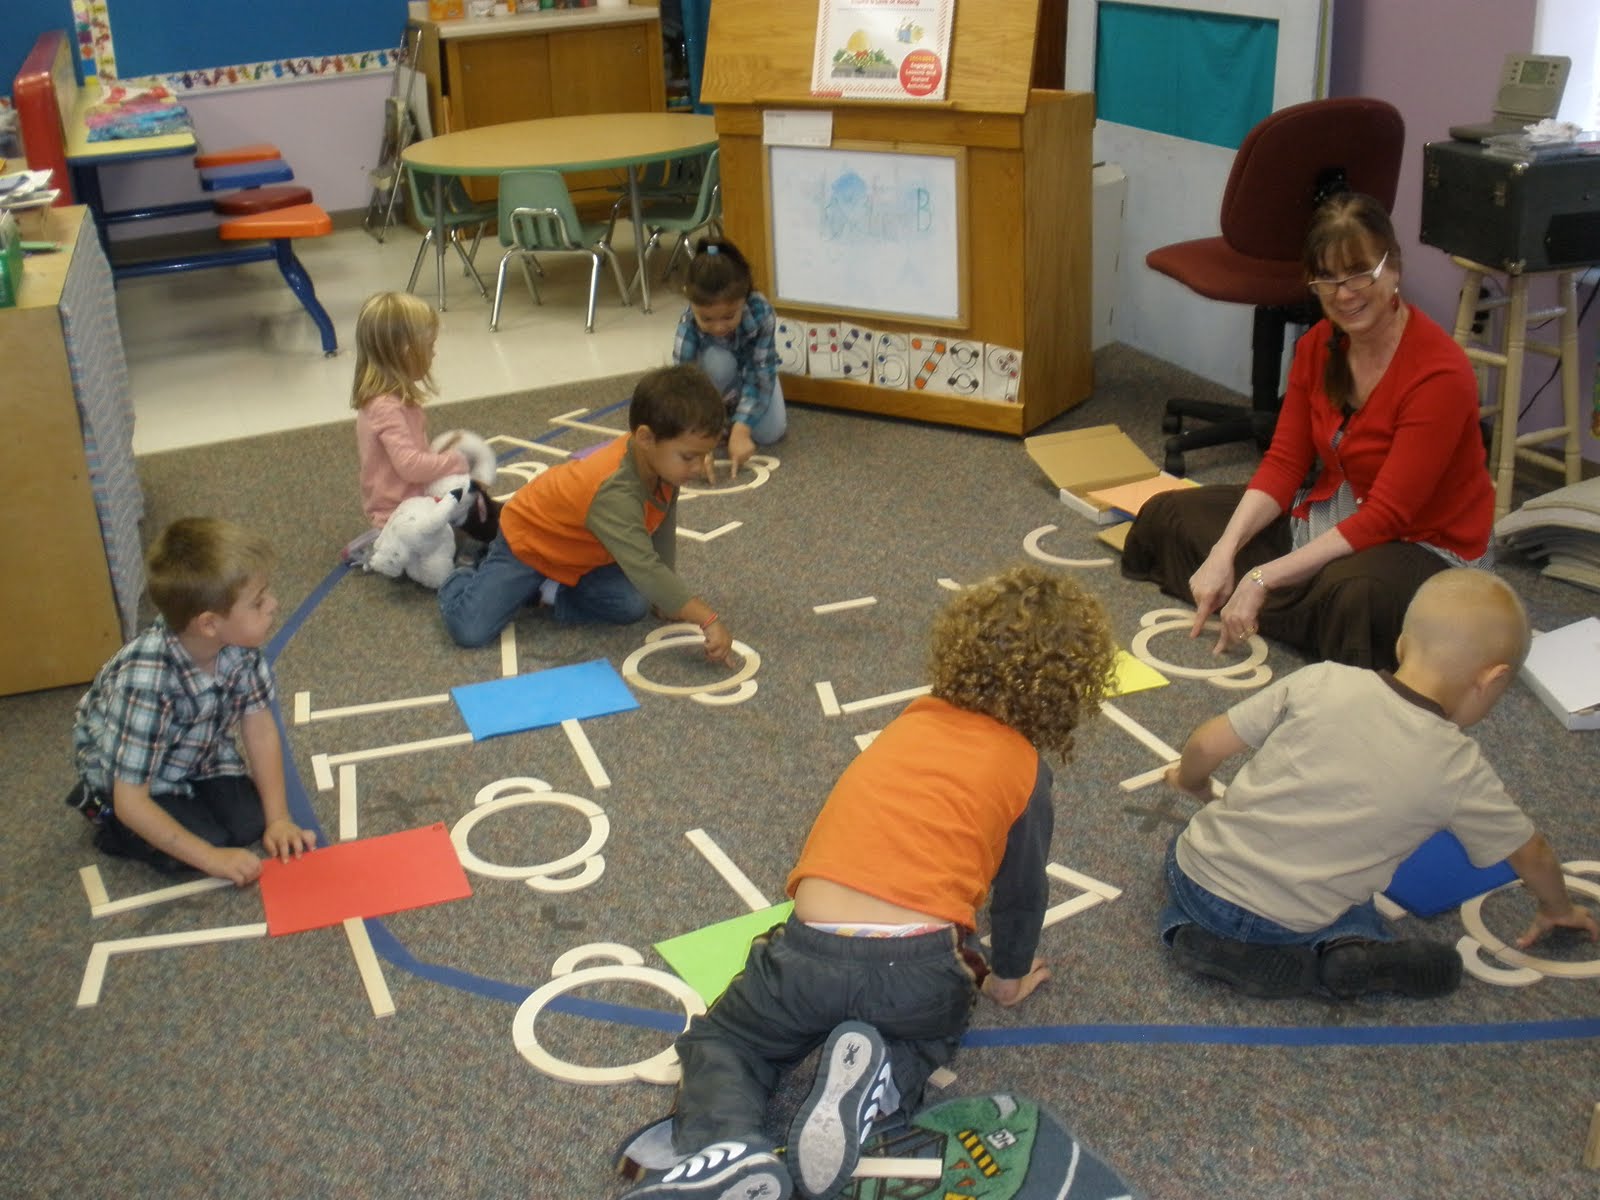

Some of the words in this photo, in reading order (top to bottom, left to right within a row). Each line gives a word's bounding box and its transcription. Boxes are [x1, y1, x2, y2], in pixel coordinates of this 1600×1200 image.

[916, 186, 933, 233] B
[911, 337, 946, 390] 7
[947, 341, 980, 395] 8
